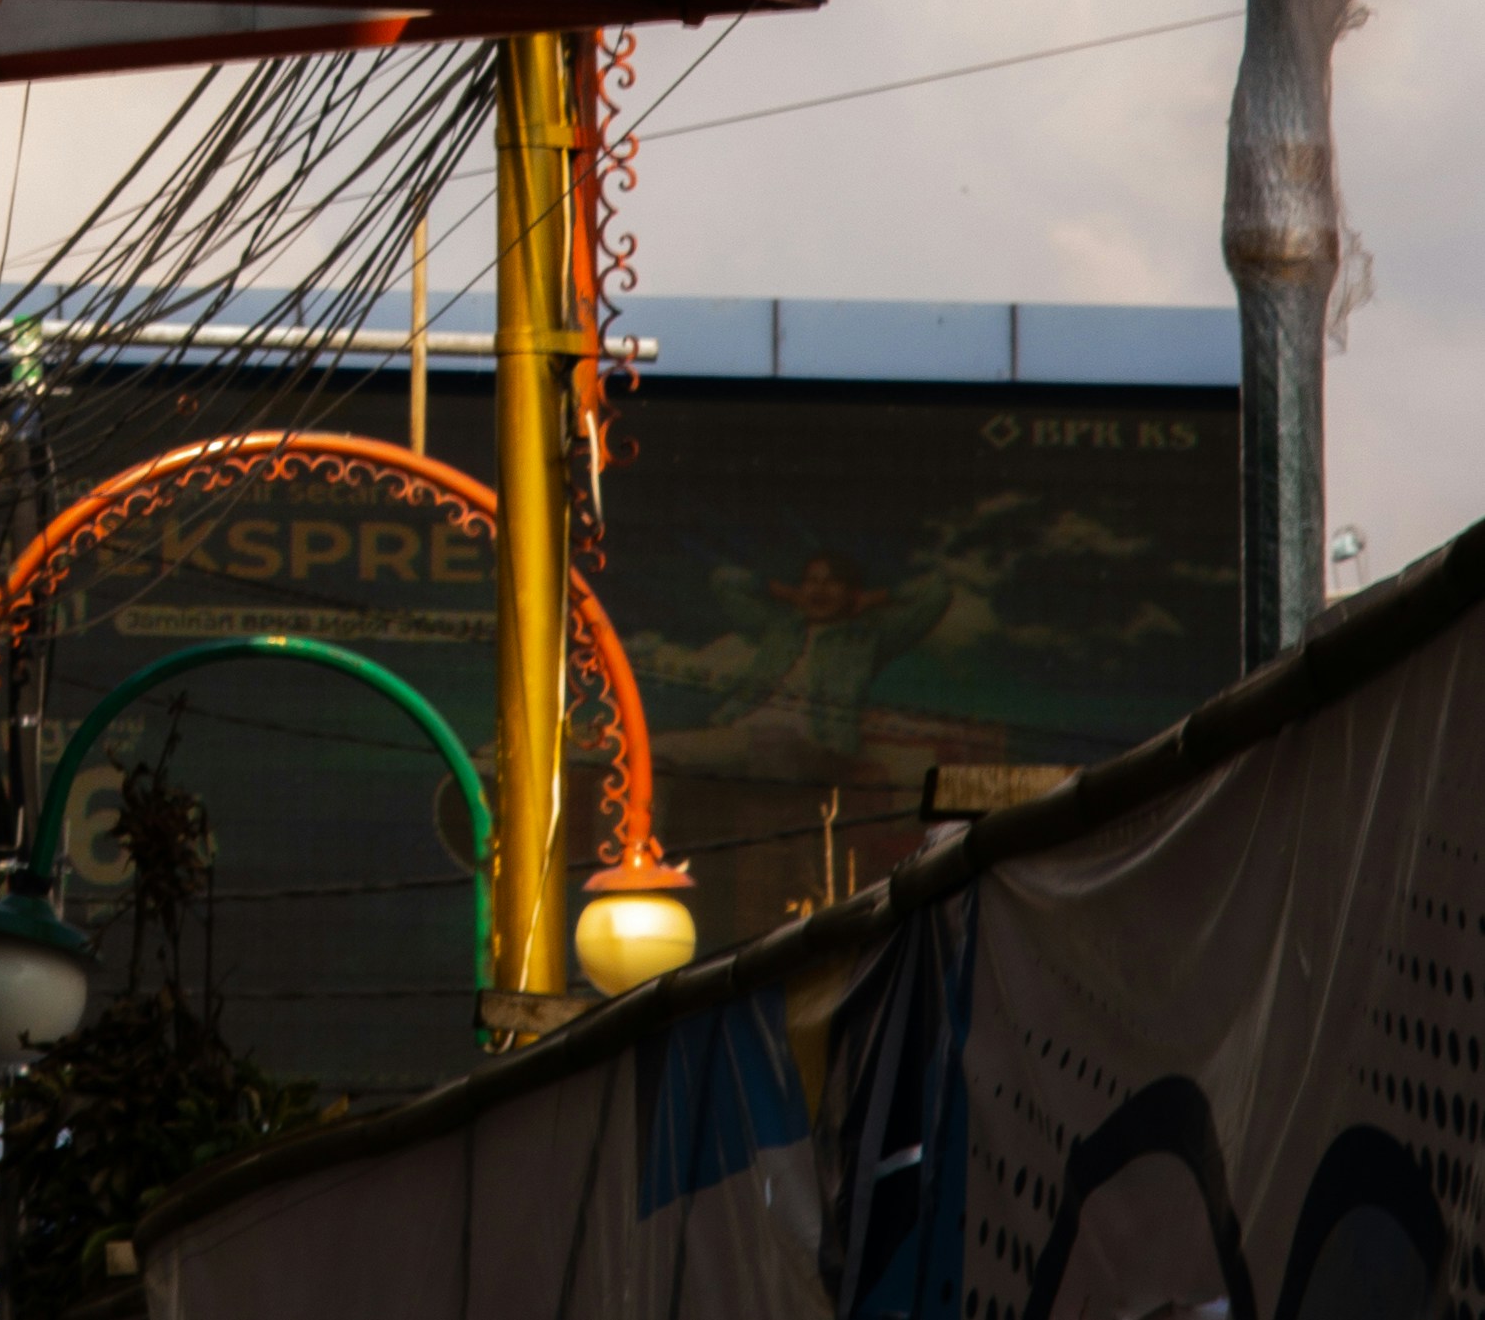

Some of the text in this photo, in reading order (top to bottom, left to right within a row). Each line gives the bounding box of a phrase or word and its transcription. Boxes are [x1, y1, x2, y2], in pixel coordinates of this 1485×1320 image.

[1030, 419, 1199, 451] BPR KS
[95, 517, 498, 585] EKSPRE
